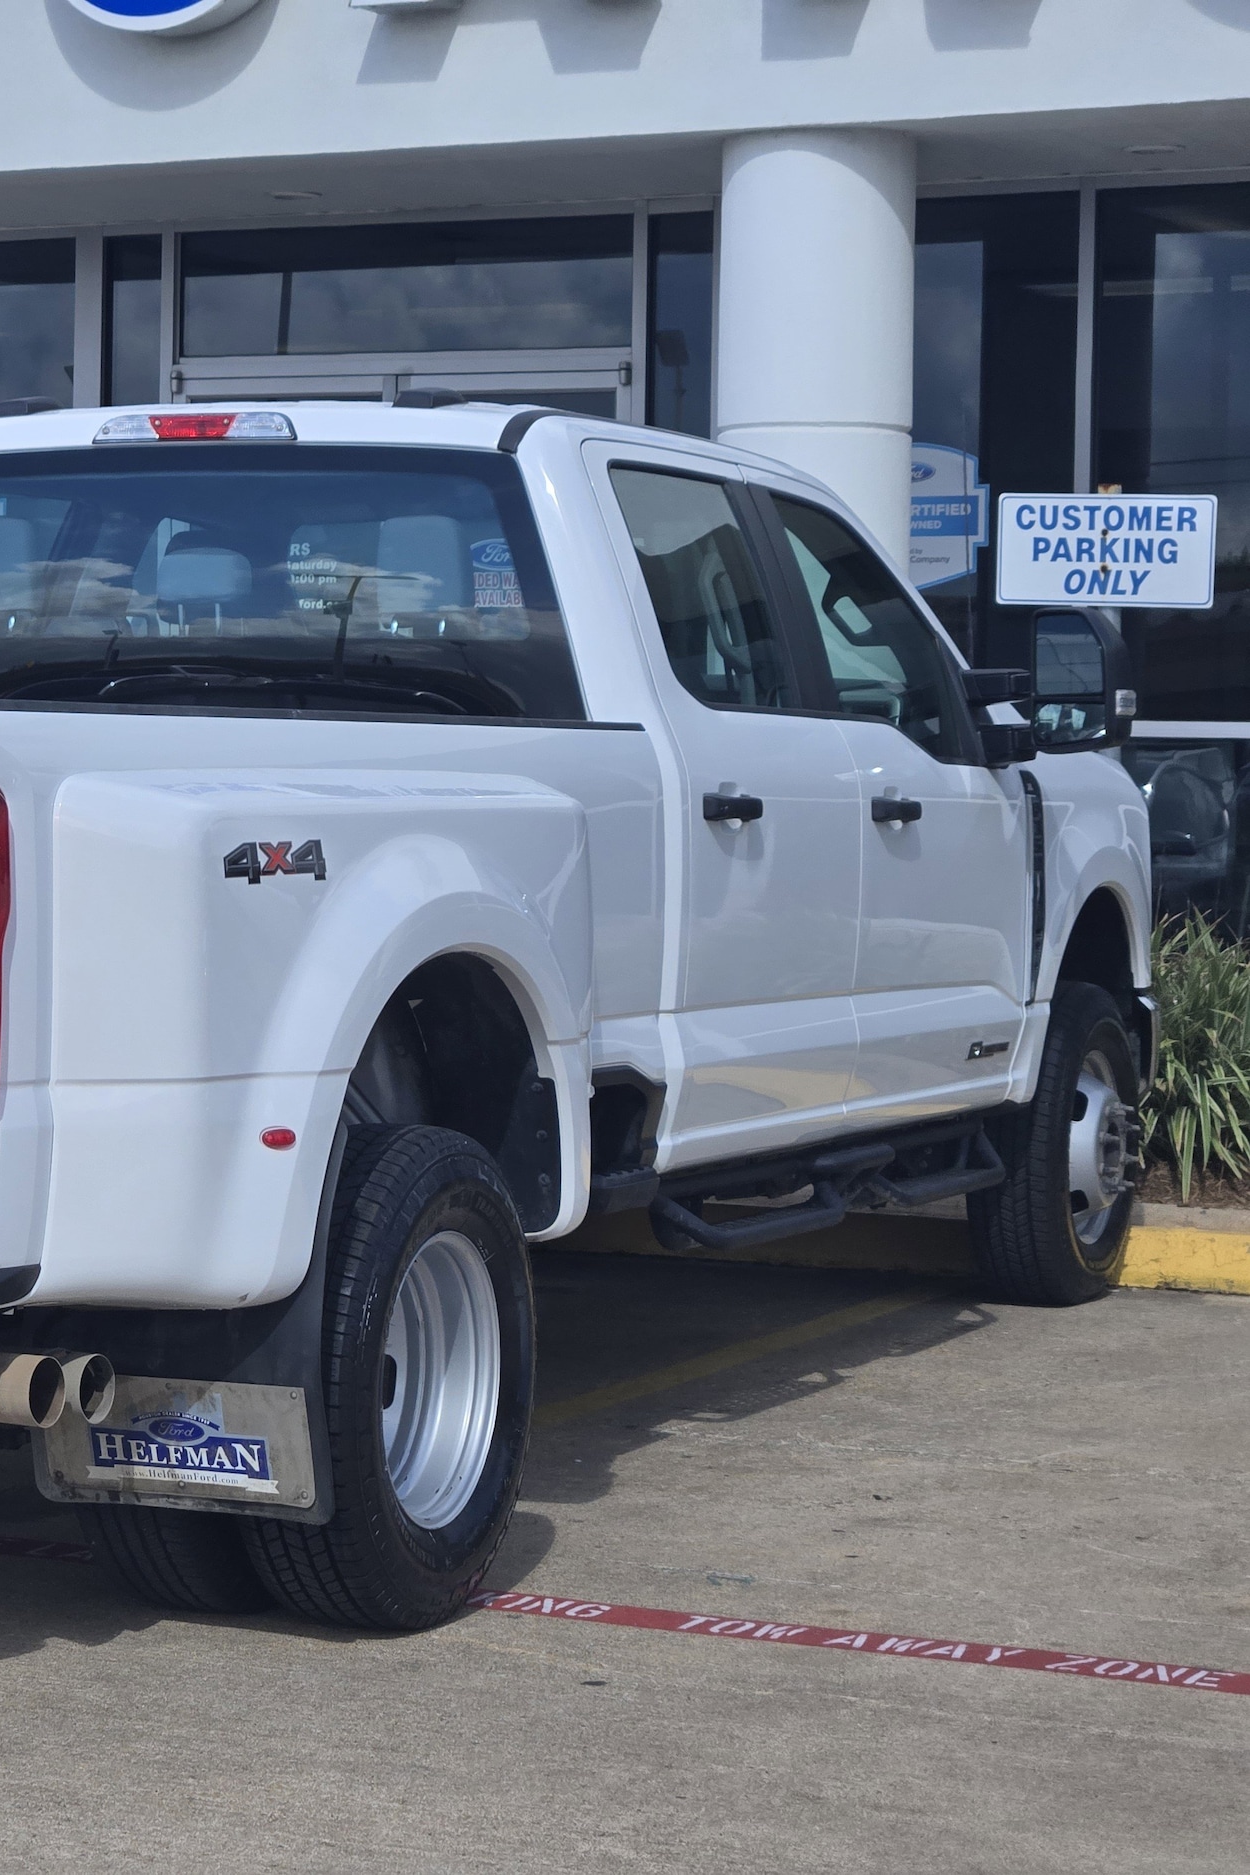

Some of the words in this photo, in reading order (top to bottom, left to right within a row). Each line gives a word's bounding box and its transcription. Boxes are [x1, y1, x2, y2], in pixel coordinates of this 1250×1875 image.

[911, 503, 972, 516] RTIFIED
[1015, 504, 1198, 532] CUSTOMER
[290, 543, 310, 556] RS
[1032, 537, 1179, 564] PARKING
[318, 576, 337, 585] pm
[1064, 568, 1151, 596] ONLY
[474, 590, 524, 608] AVAILAB
[157, 1421, 194, 1437] Ford
[95, 1432, 261, 1473] HELFMAN
[678, 1615, 809, 1639] TOW
[823, 1633, 1026, 1663] AWAY
[1045, 1654, 1237, 1688] ZONE
